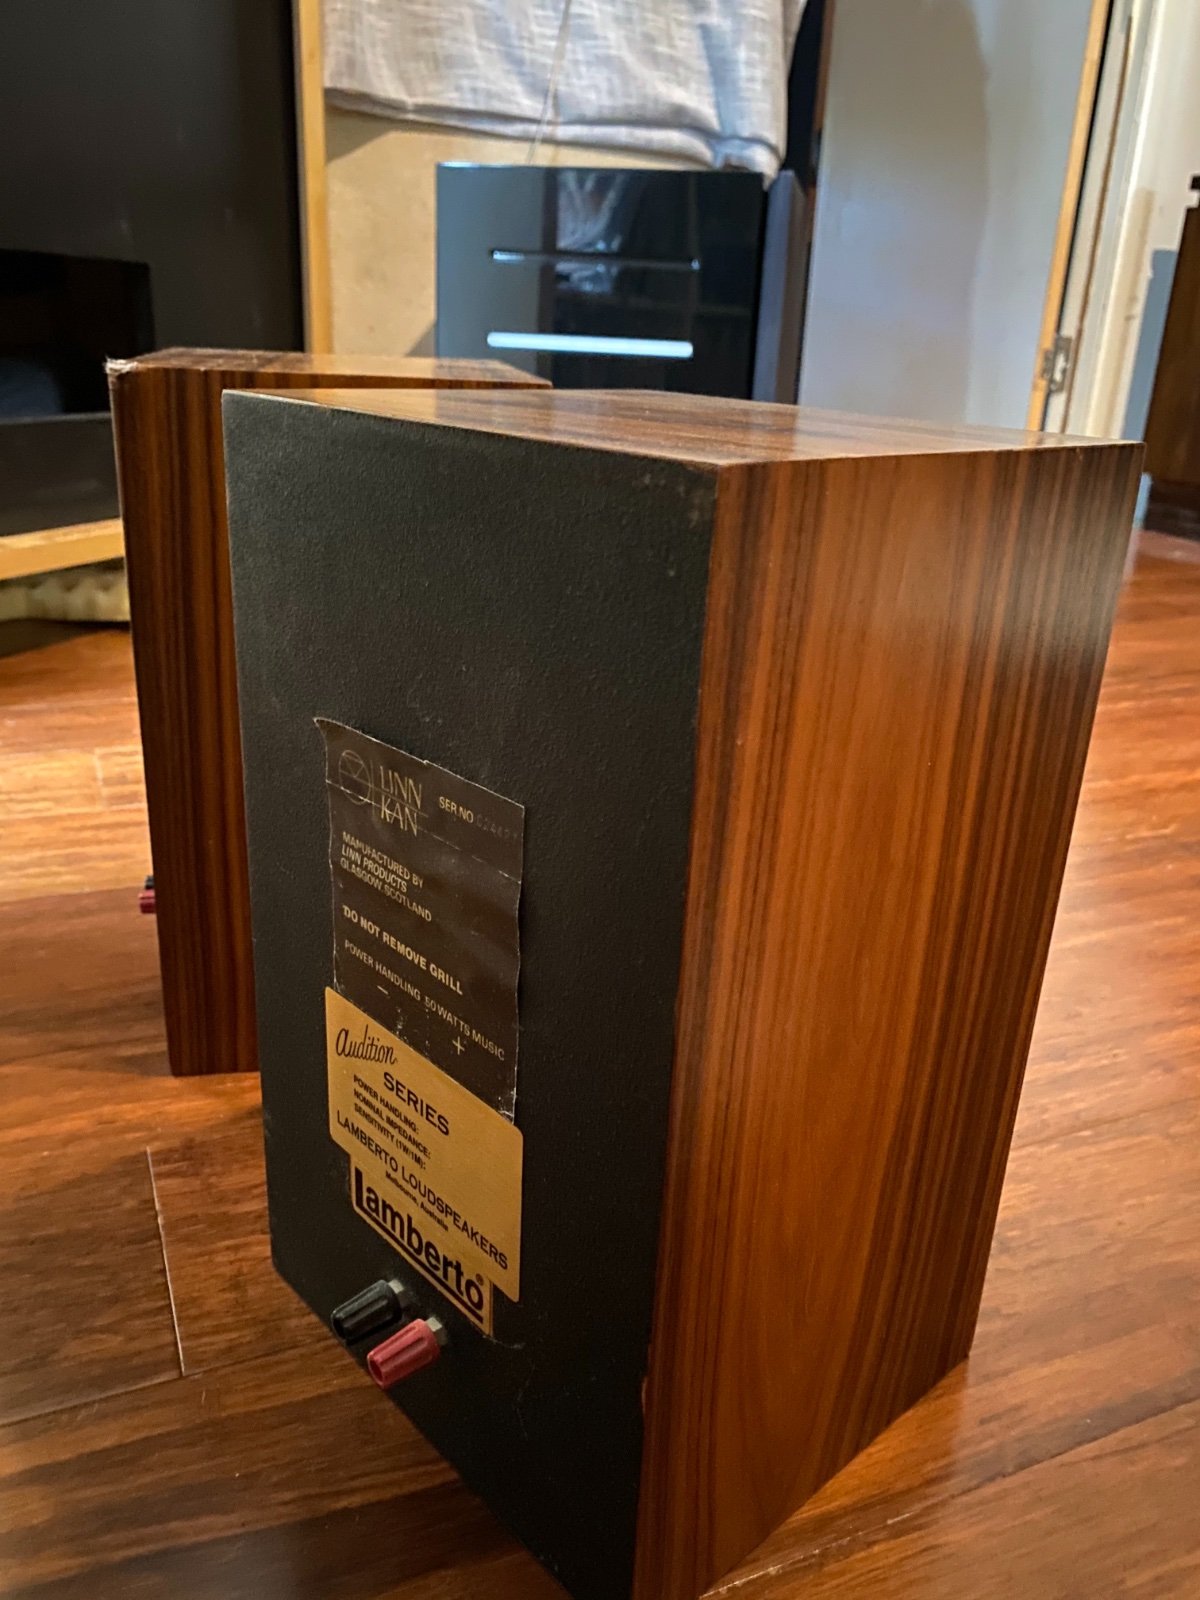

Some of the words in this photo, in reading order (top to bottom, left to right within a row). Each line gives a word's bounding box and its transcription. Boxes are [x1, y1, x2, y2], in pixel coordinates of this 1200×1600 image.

[380, 765, 422, 809] LINN
[381, 795, 418, 836] KAN
[341, 843, 362, 865] LINN
[363, 857, 408, 893] PRODUCTS
[342, 831, 411, 880] MANUFACTURED
[412, 873, 424, 888] BY
[384, 884, 432, 922] SCOTLAND
[342, 904, 359, 923] DO
[360, 916, 381, 938] NOT
[382, 931, 427, 970] REMOVE
[429, 963, 463, 996] GRILL
[344, 939, 374, 968] POWER
[375, 961, 421, 1001] HANDLING
[472, 1029, 505, 1061] MUSIC
[353, 1074, 378, 1101] POWER
[380, 1096, 419, 1135] HANDLING:
[353, 1088, 384, 1120] NOMINAL
[386, 1115, 431, 1159] IMPEDANCE:
[354, 1102, 394, 1143] SENSITIVITY
[383, 1071, 449, 1136] SERIES
[337, 1110, 398, 1172] LAMBERTO
[402, 1165, 508, 1271] LOUDSPEAKERS
[420, 1201, 449, 1231] Australia
